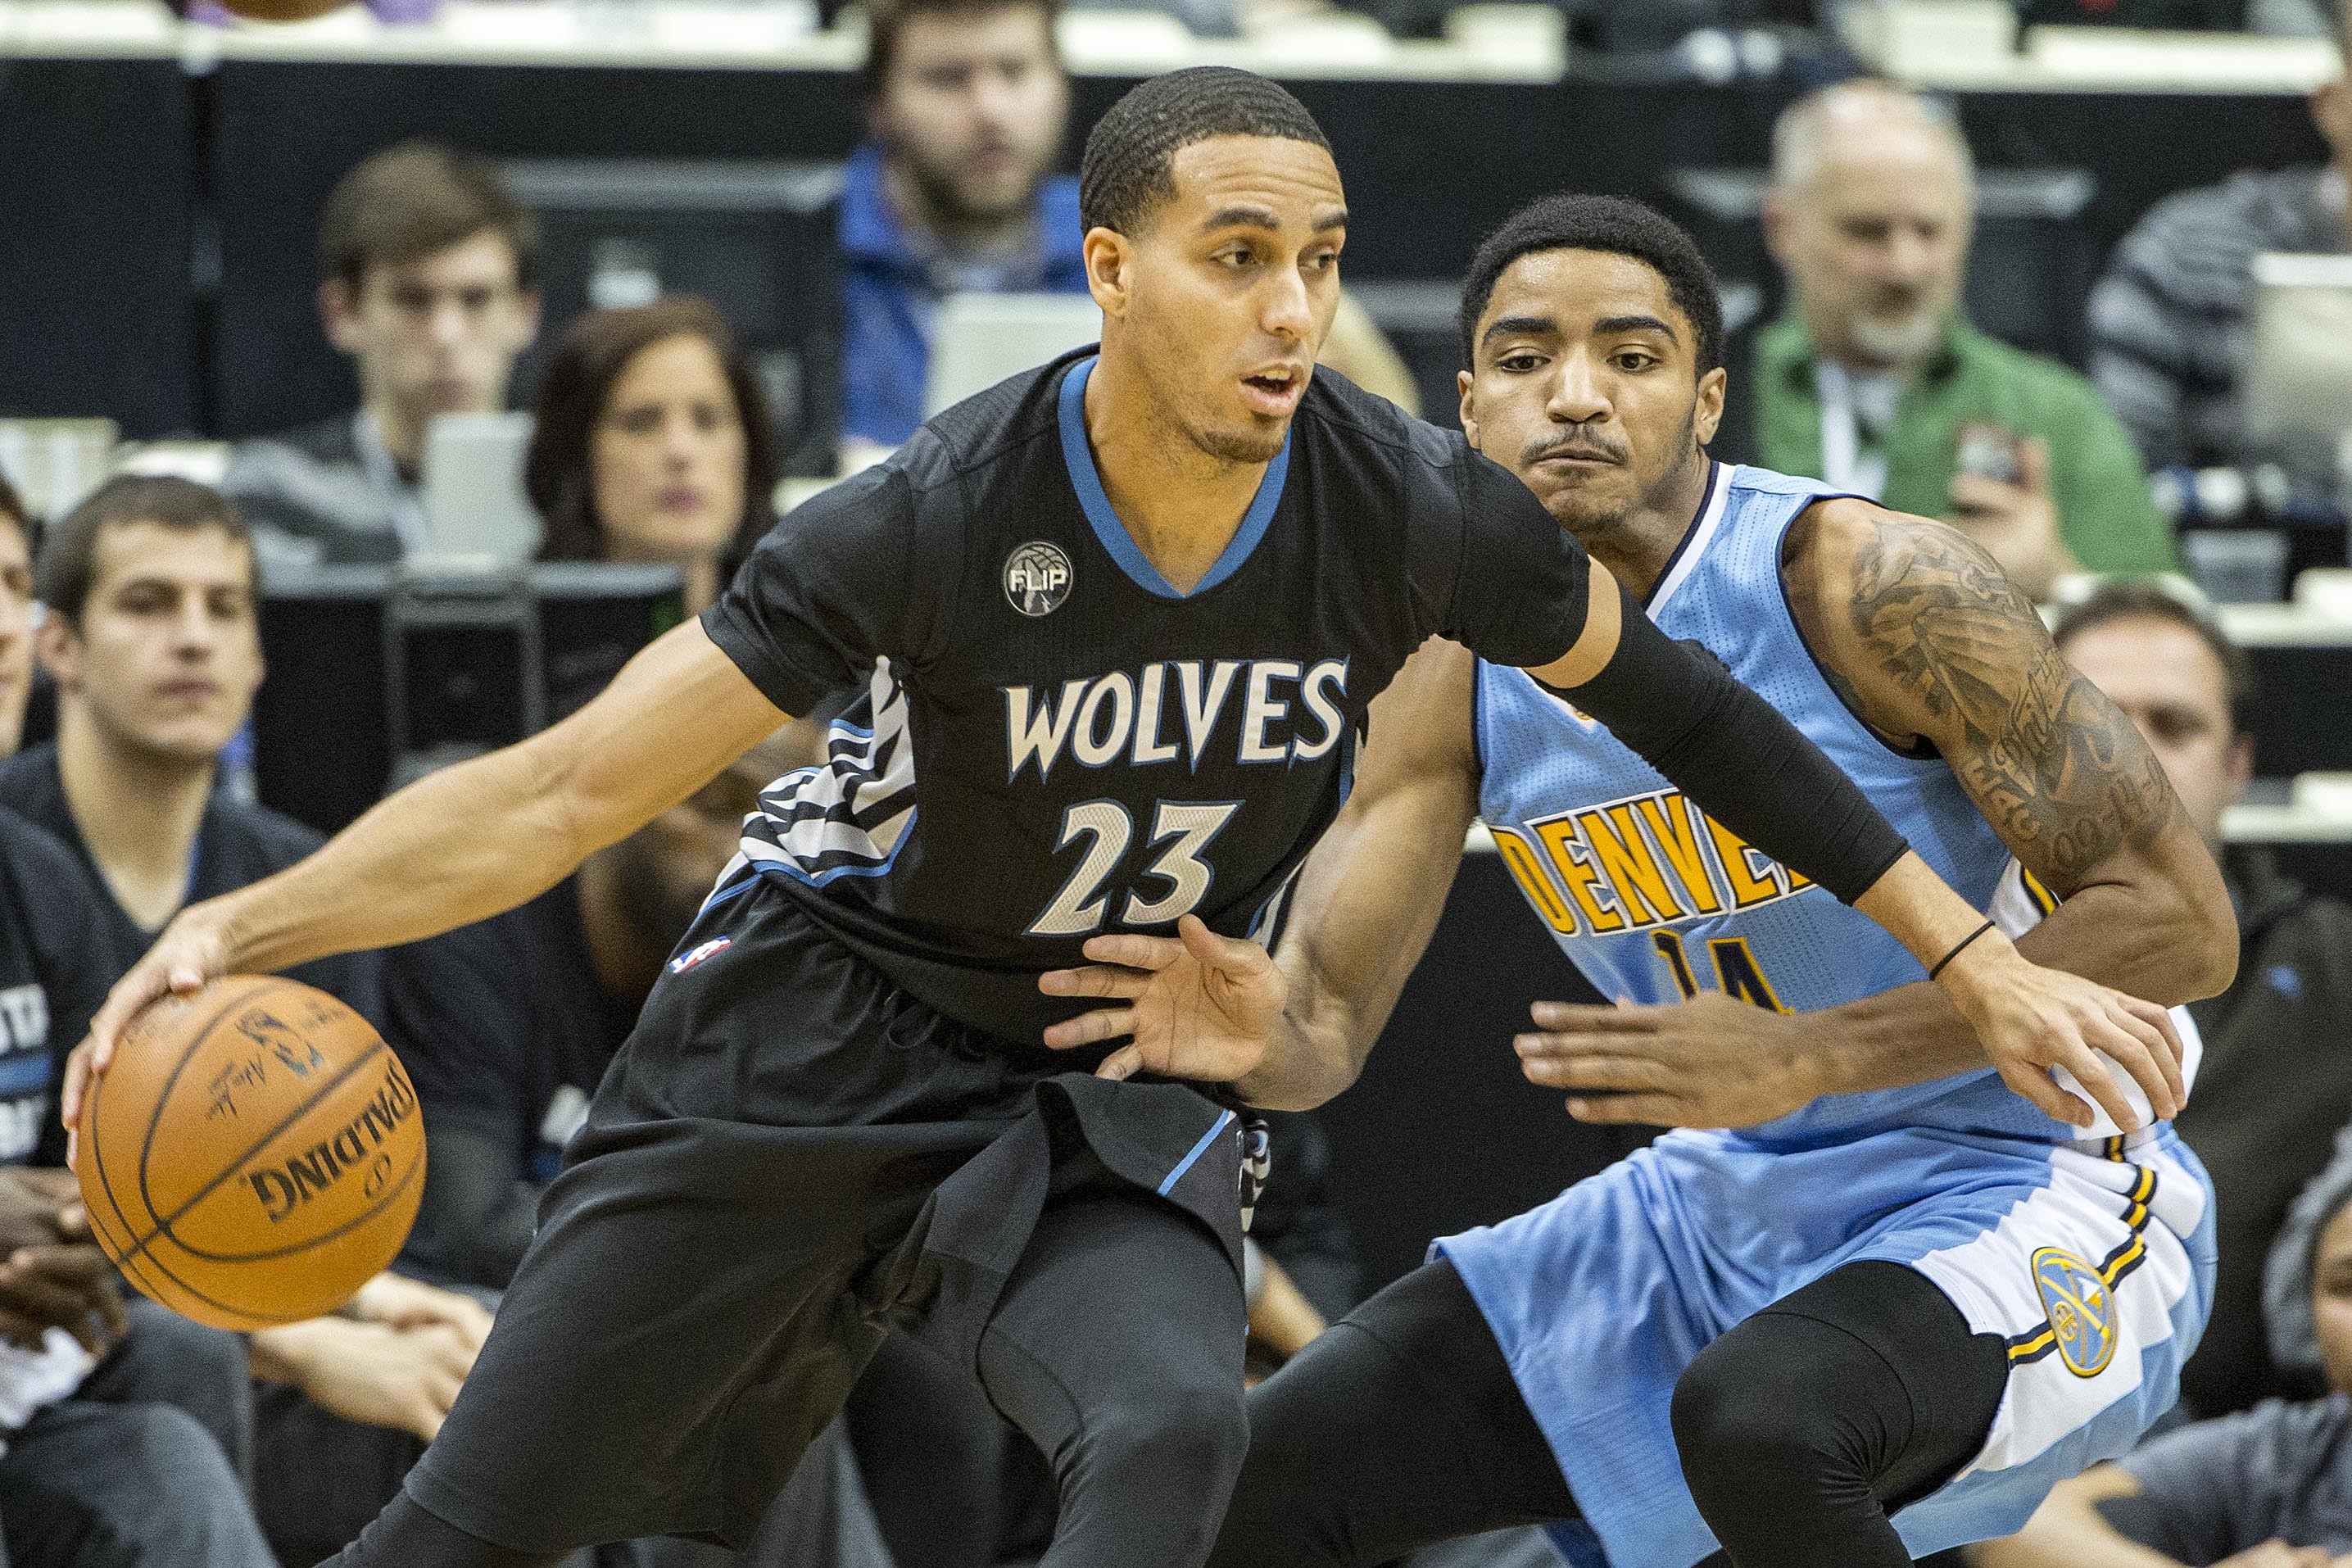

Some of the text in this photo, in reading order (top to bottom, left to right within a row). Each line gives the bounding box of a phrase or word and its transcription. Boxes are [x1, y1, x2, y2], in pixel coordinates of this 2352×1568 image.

[1008, 569, 1067, 592] FLIP
[998, 655, 1352, 786] WOLVES
[1022, 797, 1246, 938] 23
[1488, 786, 1820, 938] DENVE
[248, 1056, 415, 1225] SPALDING
